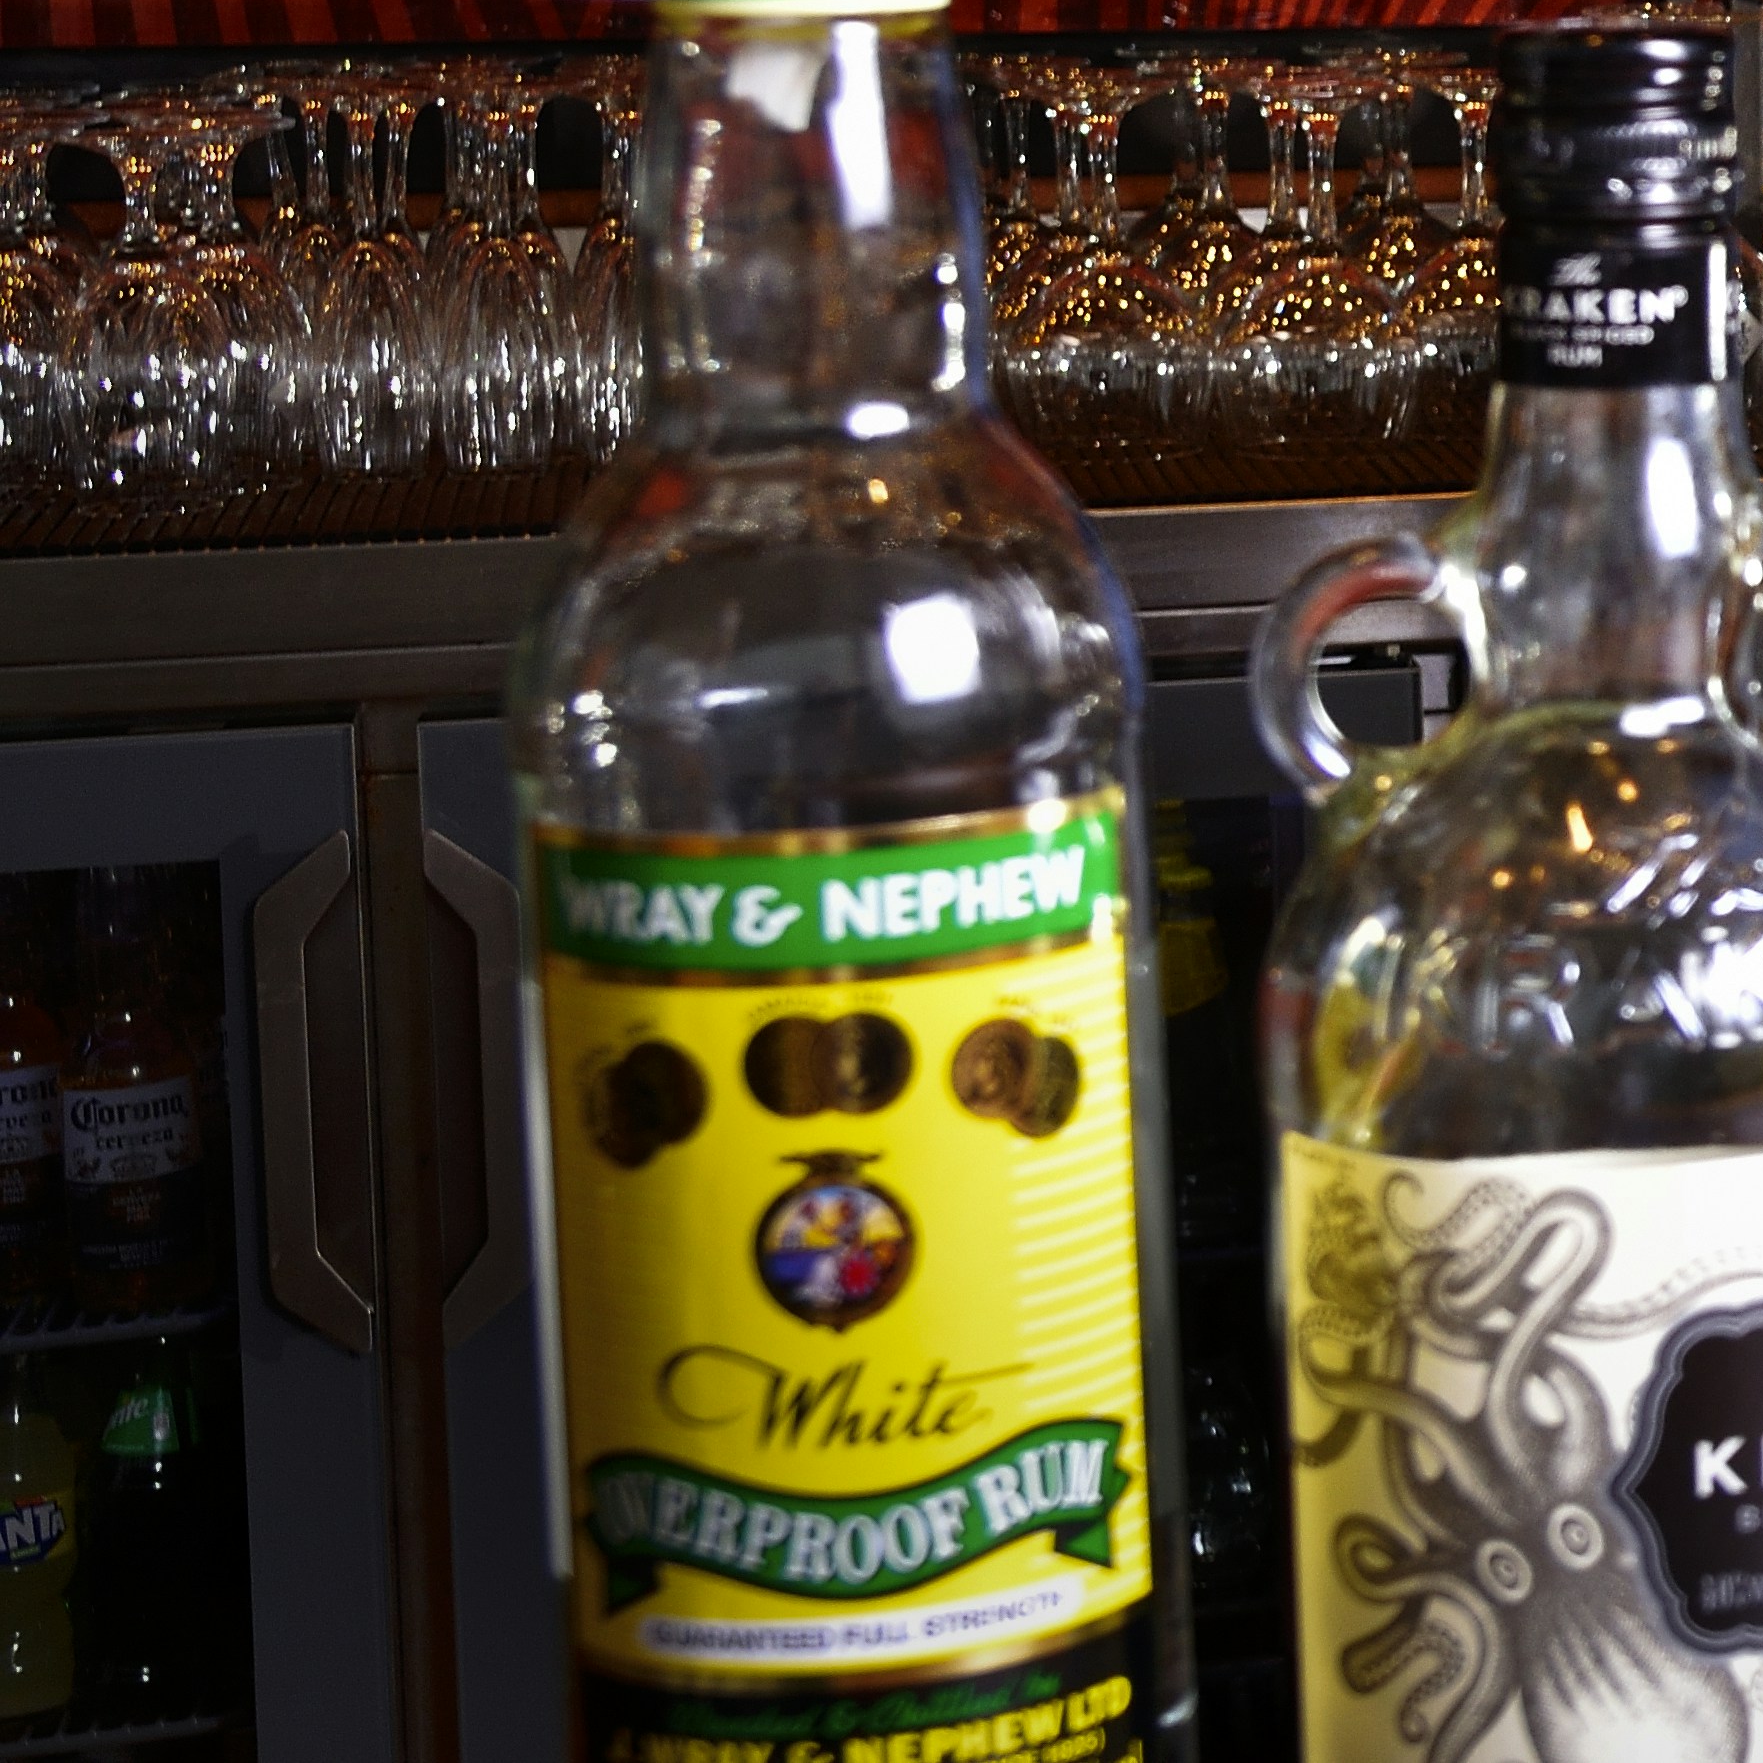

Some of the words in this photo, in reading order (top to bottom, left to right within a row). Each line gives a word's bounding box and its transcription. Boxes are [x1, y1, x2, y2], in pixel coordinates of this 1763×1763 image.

[560, 878, 726, 946] WRAY
[729, 884, 804, 948] &
[819, 844, 1087, 943] NEPHEW
[70, 1093, 190, 1133] Corona
[657, 1341, 1034, 1452] White
[0, 1502, 66, 1553] NTA
[973, 1440, 1109, 1535] RUM
